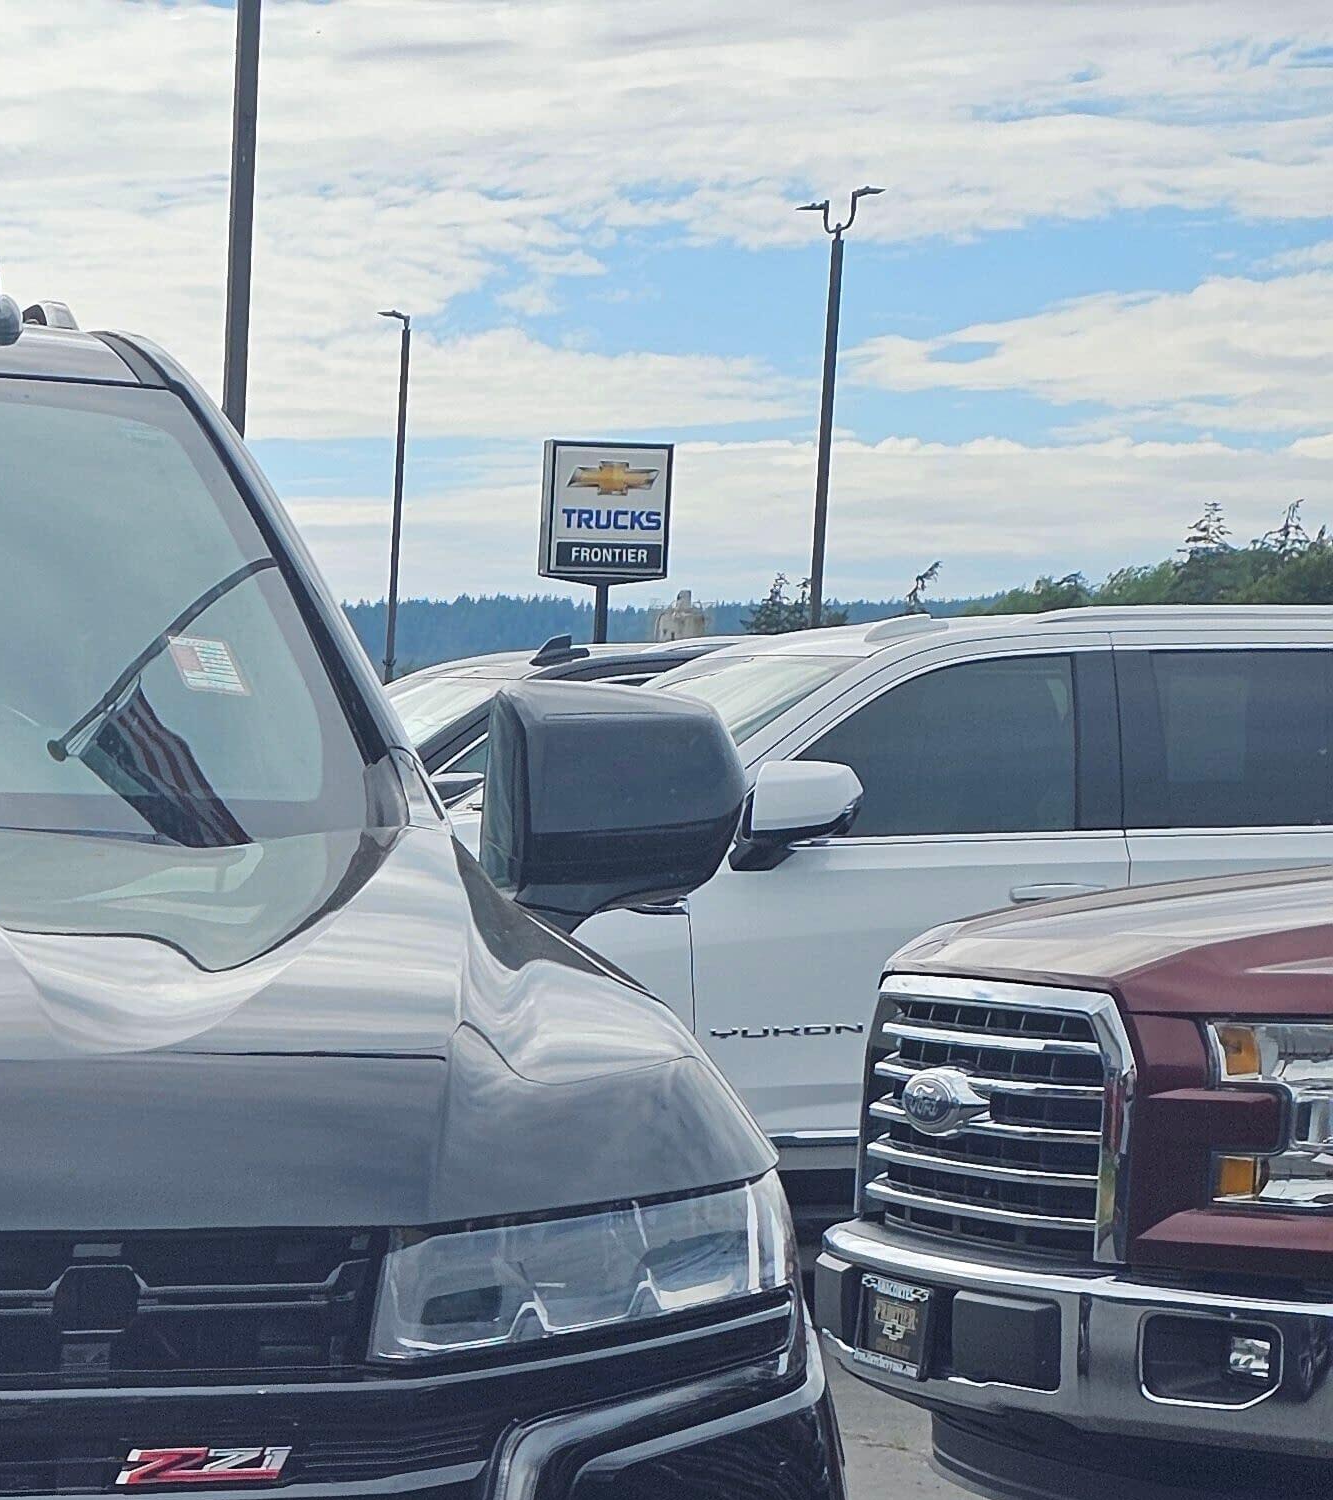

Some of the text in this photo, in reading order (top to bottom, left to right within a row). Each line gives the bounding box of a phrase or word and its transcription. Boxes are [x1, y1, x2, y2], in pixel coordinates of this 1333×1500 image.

[562, 508, 661, 530] TRUCKS
[571, 547, 647, 563] FRONTIER
[709, 1022, 863, 1039] YUKON
[115, 1446, 292, 1485] Z71
